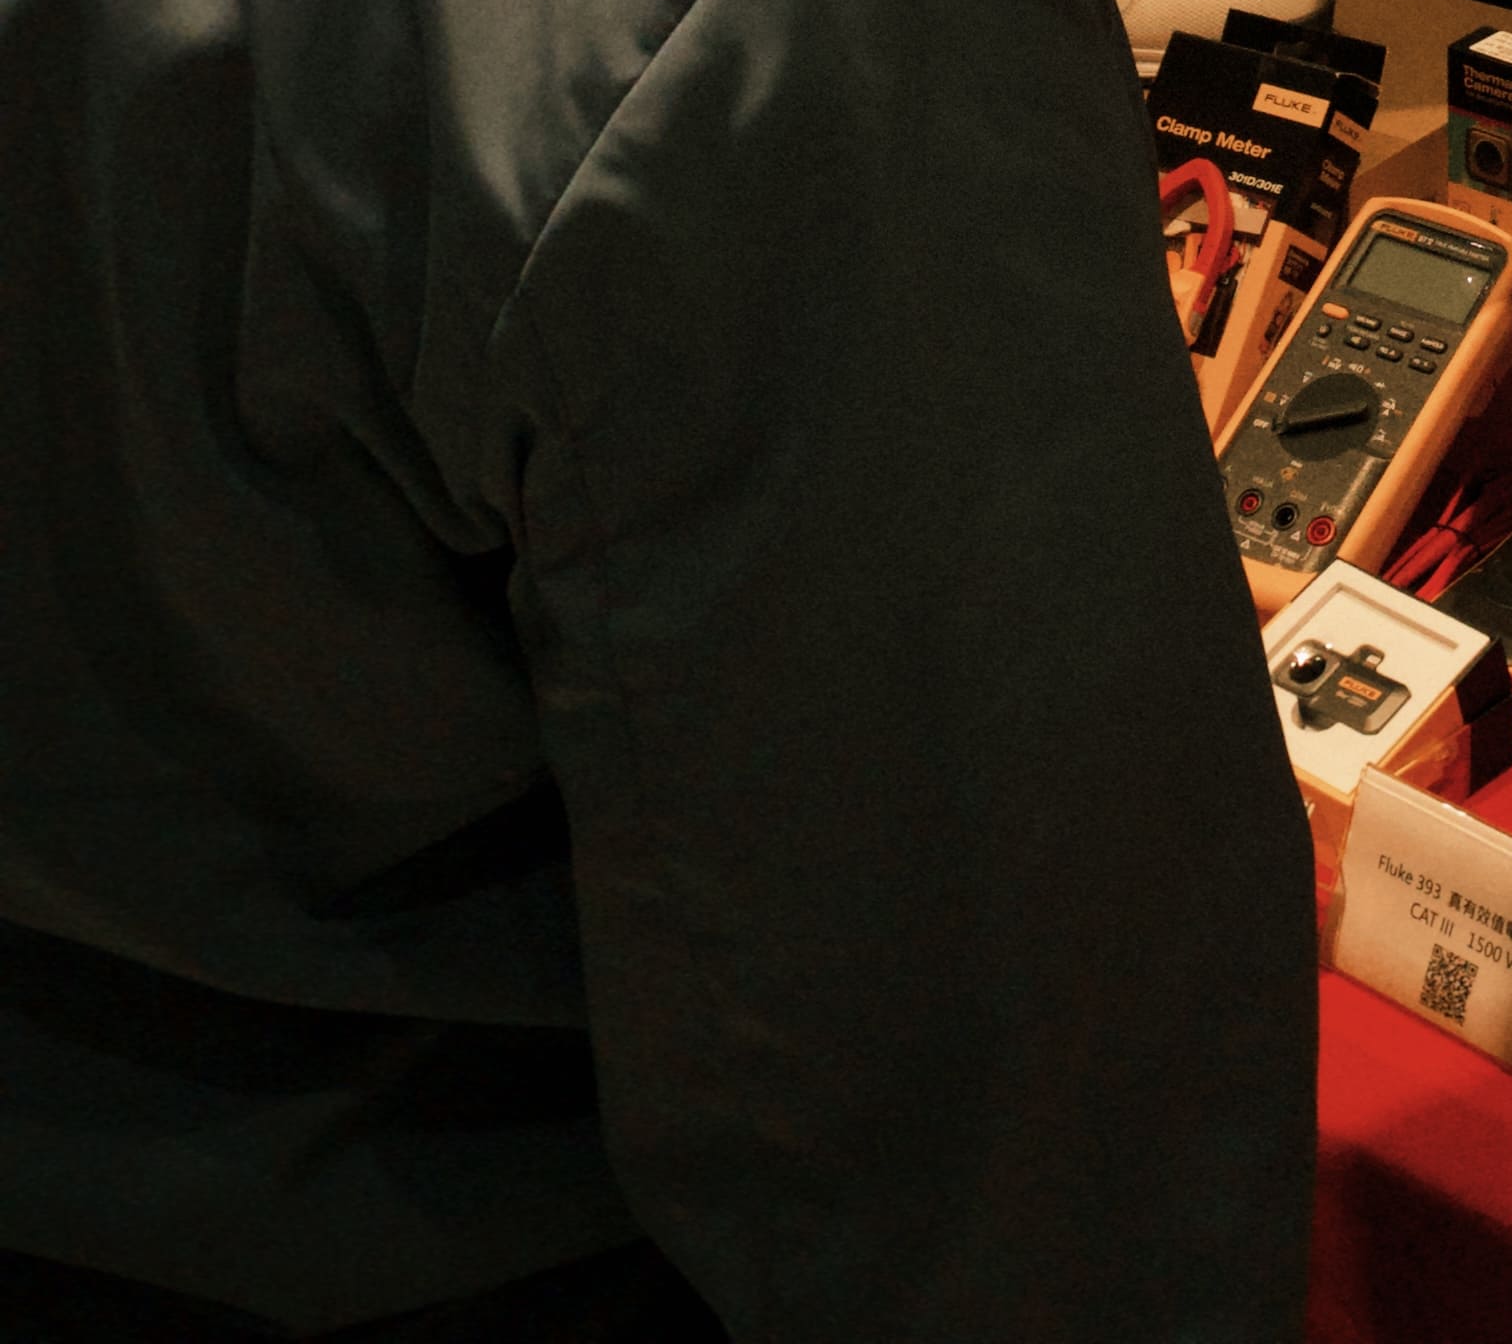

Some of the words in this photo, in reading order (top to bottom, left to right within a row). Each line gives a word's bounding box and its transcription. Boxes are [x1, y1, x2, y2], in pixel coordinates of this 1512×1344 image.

[1263, 93, 1313, 113] FLUKE
[1155, 114, 1213, 145] Clamp
[1215, 130, 1273, 161] Meter
[1377, 854, 1414, 886] Fluke
[1416, 873, 1442, 900] 393
[1409, 901, 1438, 927] CAT
[1465, 931, 1504, 964] 1500
